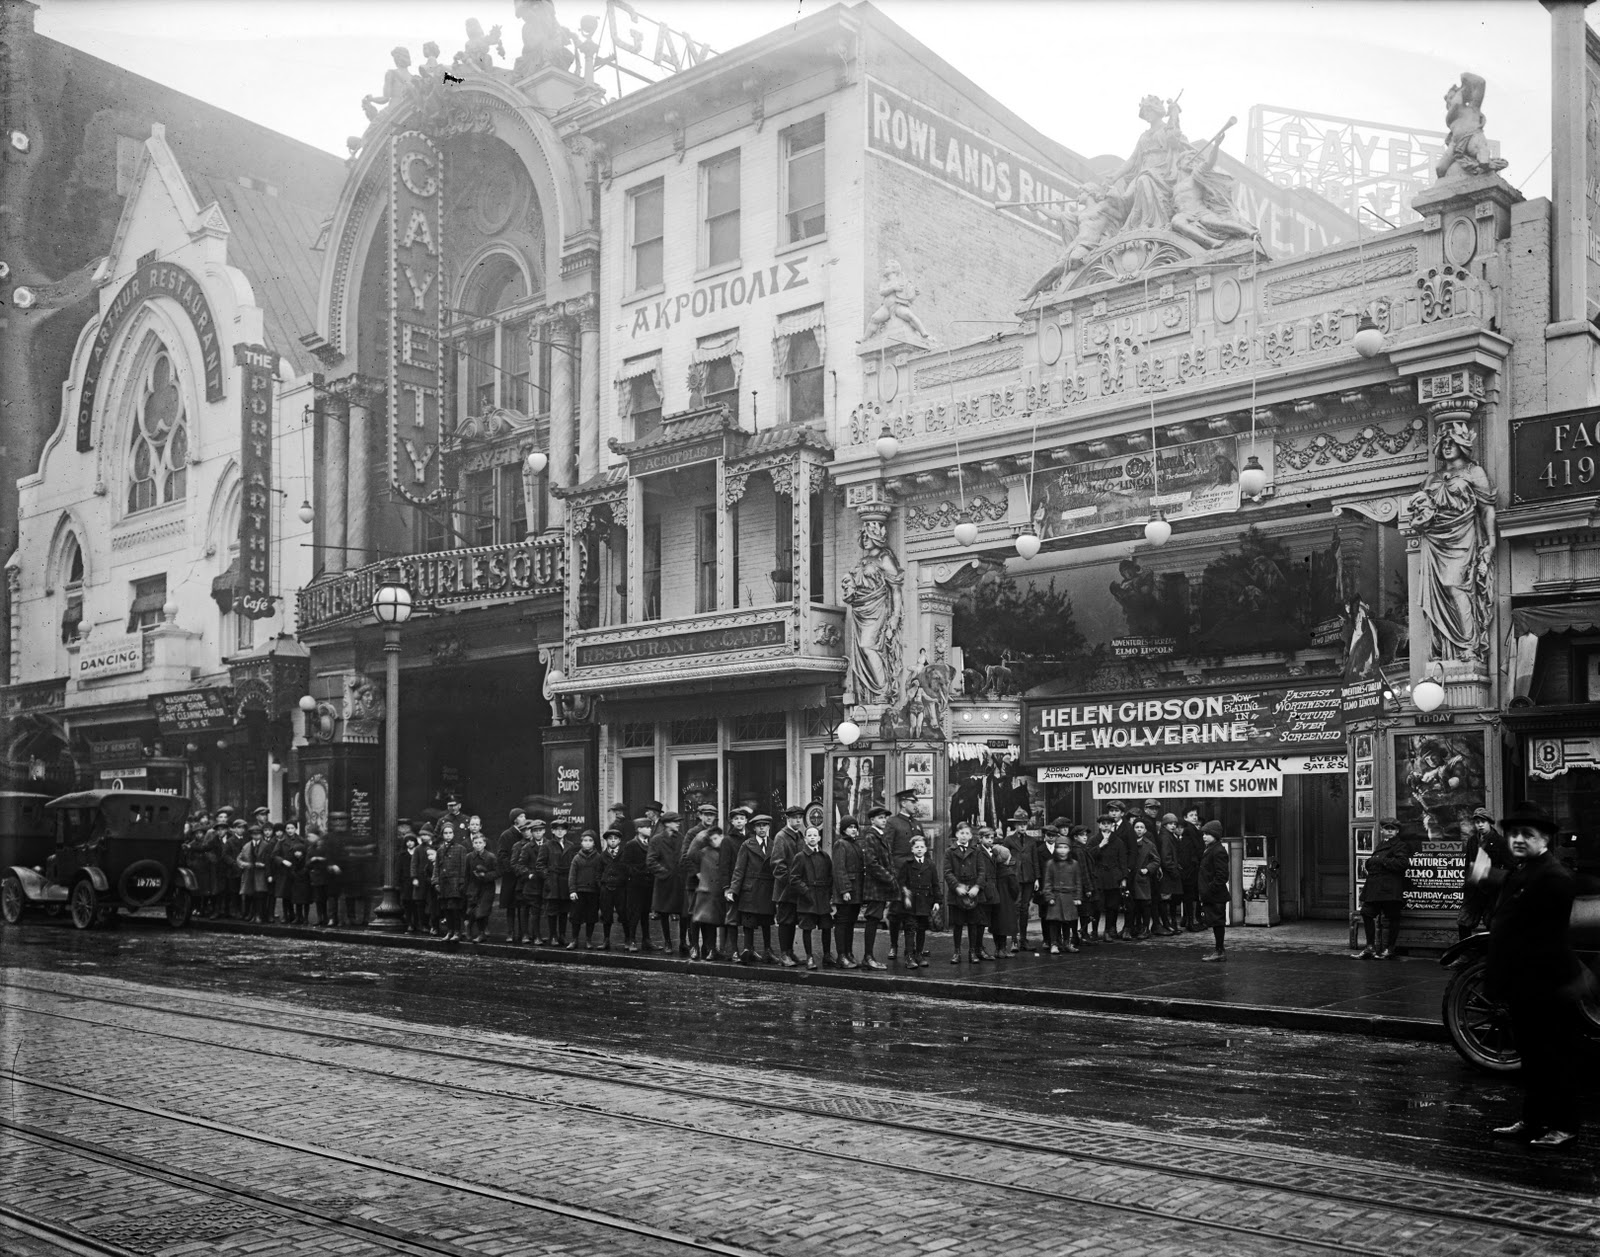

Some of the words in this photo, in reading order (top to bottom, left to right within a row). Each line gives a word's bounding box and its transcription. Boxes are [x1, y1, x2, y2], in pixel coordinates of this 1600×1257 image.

[873, 92, 1012, 202] ROWLAND'S
[1280, 122, 1446, 186] GAYET
[400, 151, 438, 485] GAYETY
[1112, 310, 1158, 337] 1910
[79, 375, 95, 442] PORT
[94, 279, 141, 362] ARTHUR
[150, 269, 220, 389] RESTAURANT
[245, 350, 272, 368] THE
[251, 375, 267, 457] PORT
[645, 446, 708, 470] ACROPOLIS
[1539, 457, 1595, 488] 419
[250, 473, 266, 593] ARTHUR
[243, 594, 269, 612] Café
[582, 638, 695, 664] RESTAURANT
[703, 634, 716, 650] &
[1115, 647, 1138, 655] ELMO
[1140, 646, 1174, 655] LINCOLN
[81, 650, 140, 671] DANCING.
[164, 693, 203, 704] WASHINGTON
[1230, 693, 1252, 704] NOW
[1282, 689, 1335, 701] FASTEST
[165, 703, 185, 713] SHOE
[186, 701, 208, 711] SHINE
[1224, 702, 1259, 713] PLAYING
[1272, 698, 1341, 714] NORTHWESTER
[1343, 700, 1358, 711] ELMO
[1359, 696, 1380, 708] LINCOLN
[177, 711, 203, 720] CLEANING
[203, 708, 225, 718] PARLOR
[1041, 704, 1112, 727] HELEN
[1119, 697, 1223, 722] GIBSON
[1286, 710, 1336, 722] PICTURE
[1292, 721, 1327, 731] EVER
[1279, 731, 1341, 742] SCREENED
[1309, 754, 1347, 762] EVERY
[1543, 745, 1556, 761] B
[1044, 766, 1069, 774] ADDED
[1186, 763, 1199, 771] OF
[1302, 762, 1325, 771] SAT.
[557, 765, 580, 781] SUGAR
[1043, 771, 1084, 780] ATTRACTION
[558, 781, 580, 794] PLUMS
[1097, 780, 1155, 795] POSITIVELY
[1159, 779, 1195, 794] FIRST
[1198, 778, 1226, 793] TIME
[1229, 777, 1278, 792] SHOWN
[553, 807, 573, 816] HARRY
[1423, 842, 1462, 852] TO-DAY
[1408, 858, 1447, 867] VENTURES
[1404, 869, 1434, 879] ELMO
[1402, 891, 1443, 900] SATURDAY
